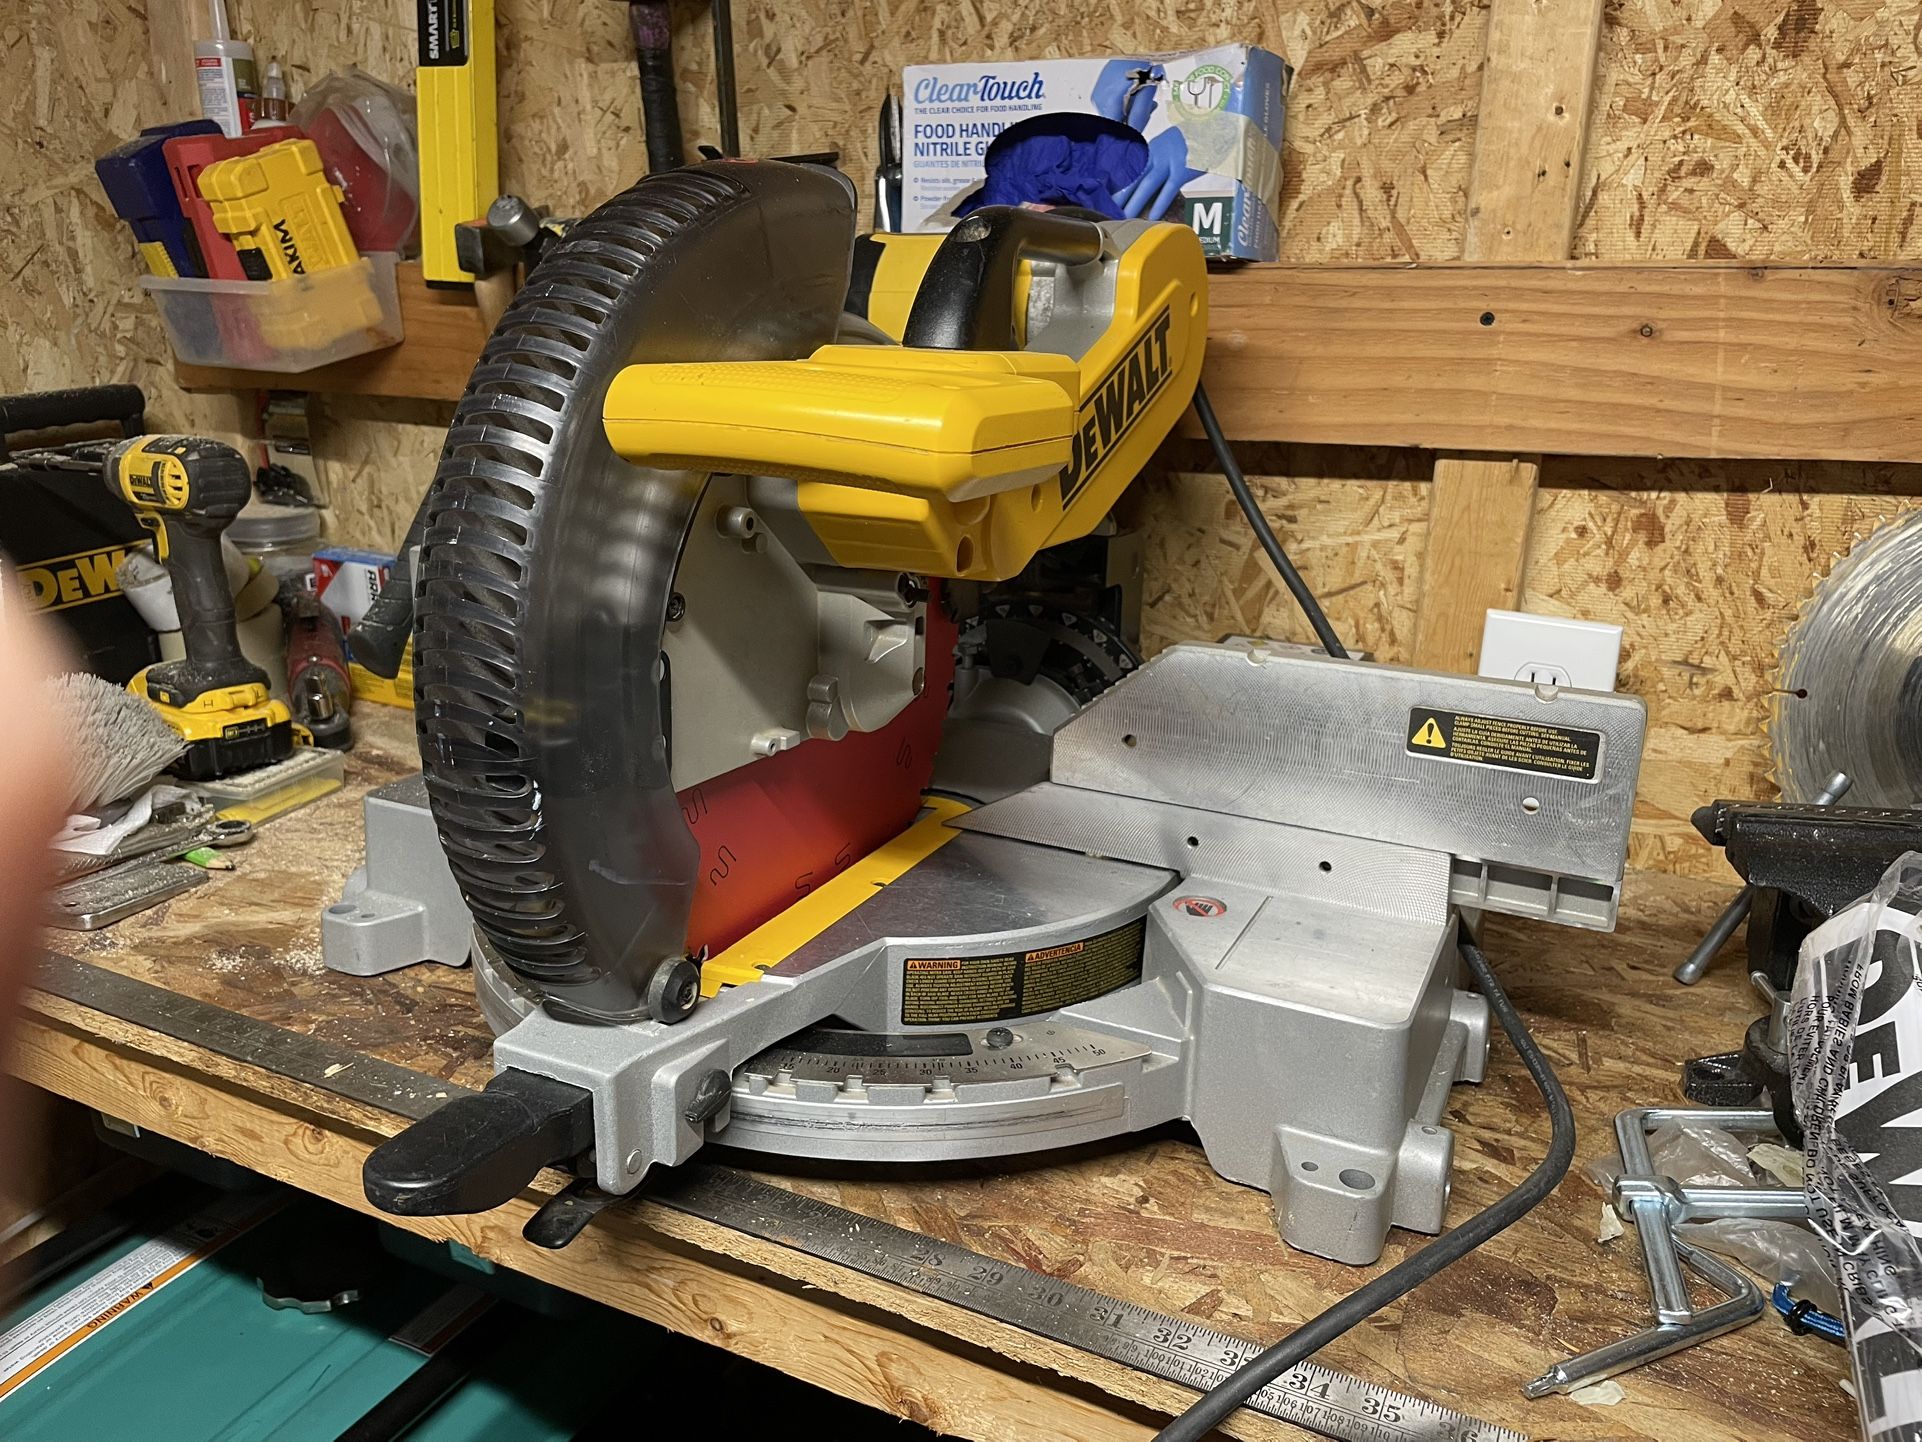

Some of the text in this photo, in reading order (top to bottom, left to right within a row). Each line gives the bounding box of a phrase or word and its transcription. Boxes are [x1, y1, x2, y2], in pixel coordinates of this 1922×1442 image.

[914, 124, 955, 139] FOOD
[914, 142, 972, 156] NITRILE
[1193, 203, 1222, 234] M
[20, 549, 128, 609] DEW
[1034, 943, 1082, 960] ADVERTENCIA
[918, 960, 959, 970] WARNING
[1010, 1062, 1022, 1070] 40
[1093, 1048, 1105, 1056] 50
[87, 1291, 142, 1328] WARNING
[909, 1247, 946, 1266] 28
[967, 1265, 1003, 1286] 29
[1089, 1306, 1125, 1330] 31
[1153, 1327, 1192, 1350] 32
[1220, 1350, 1254, 1366] 3
[1289, 1373, 1330, 1400] 34
[1362, 1397, 1401, 1422] 35
